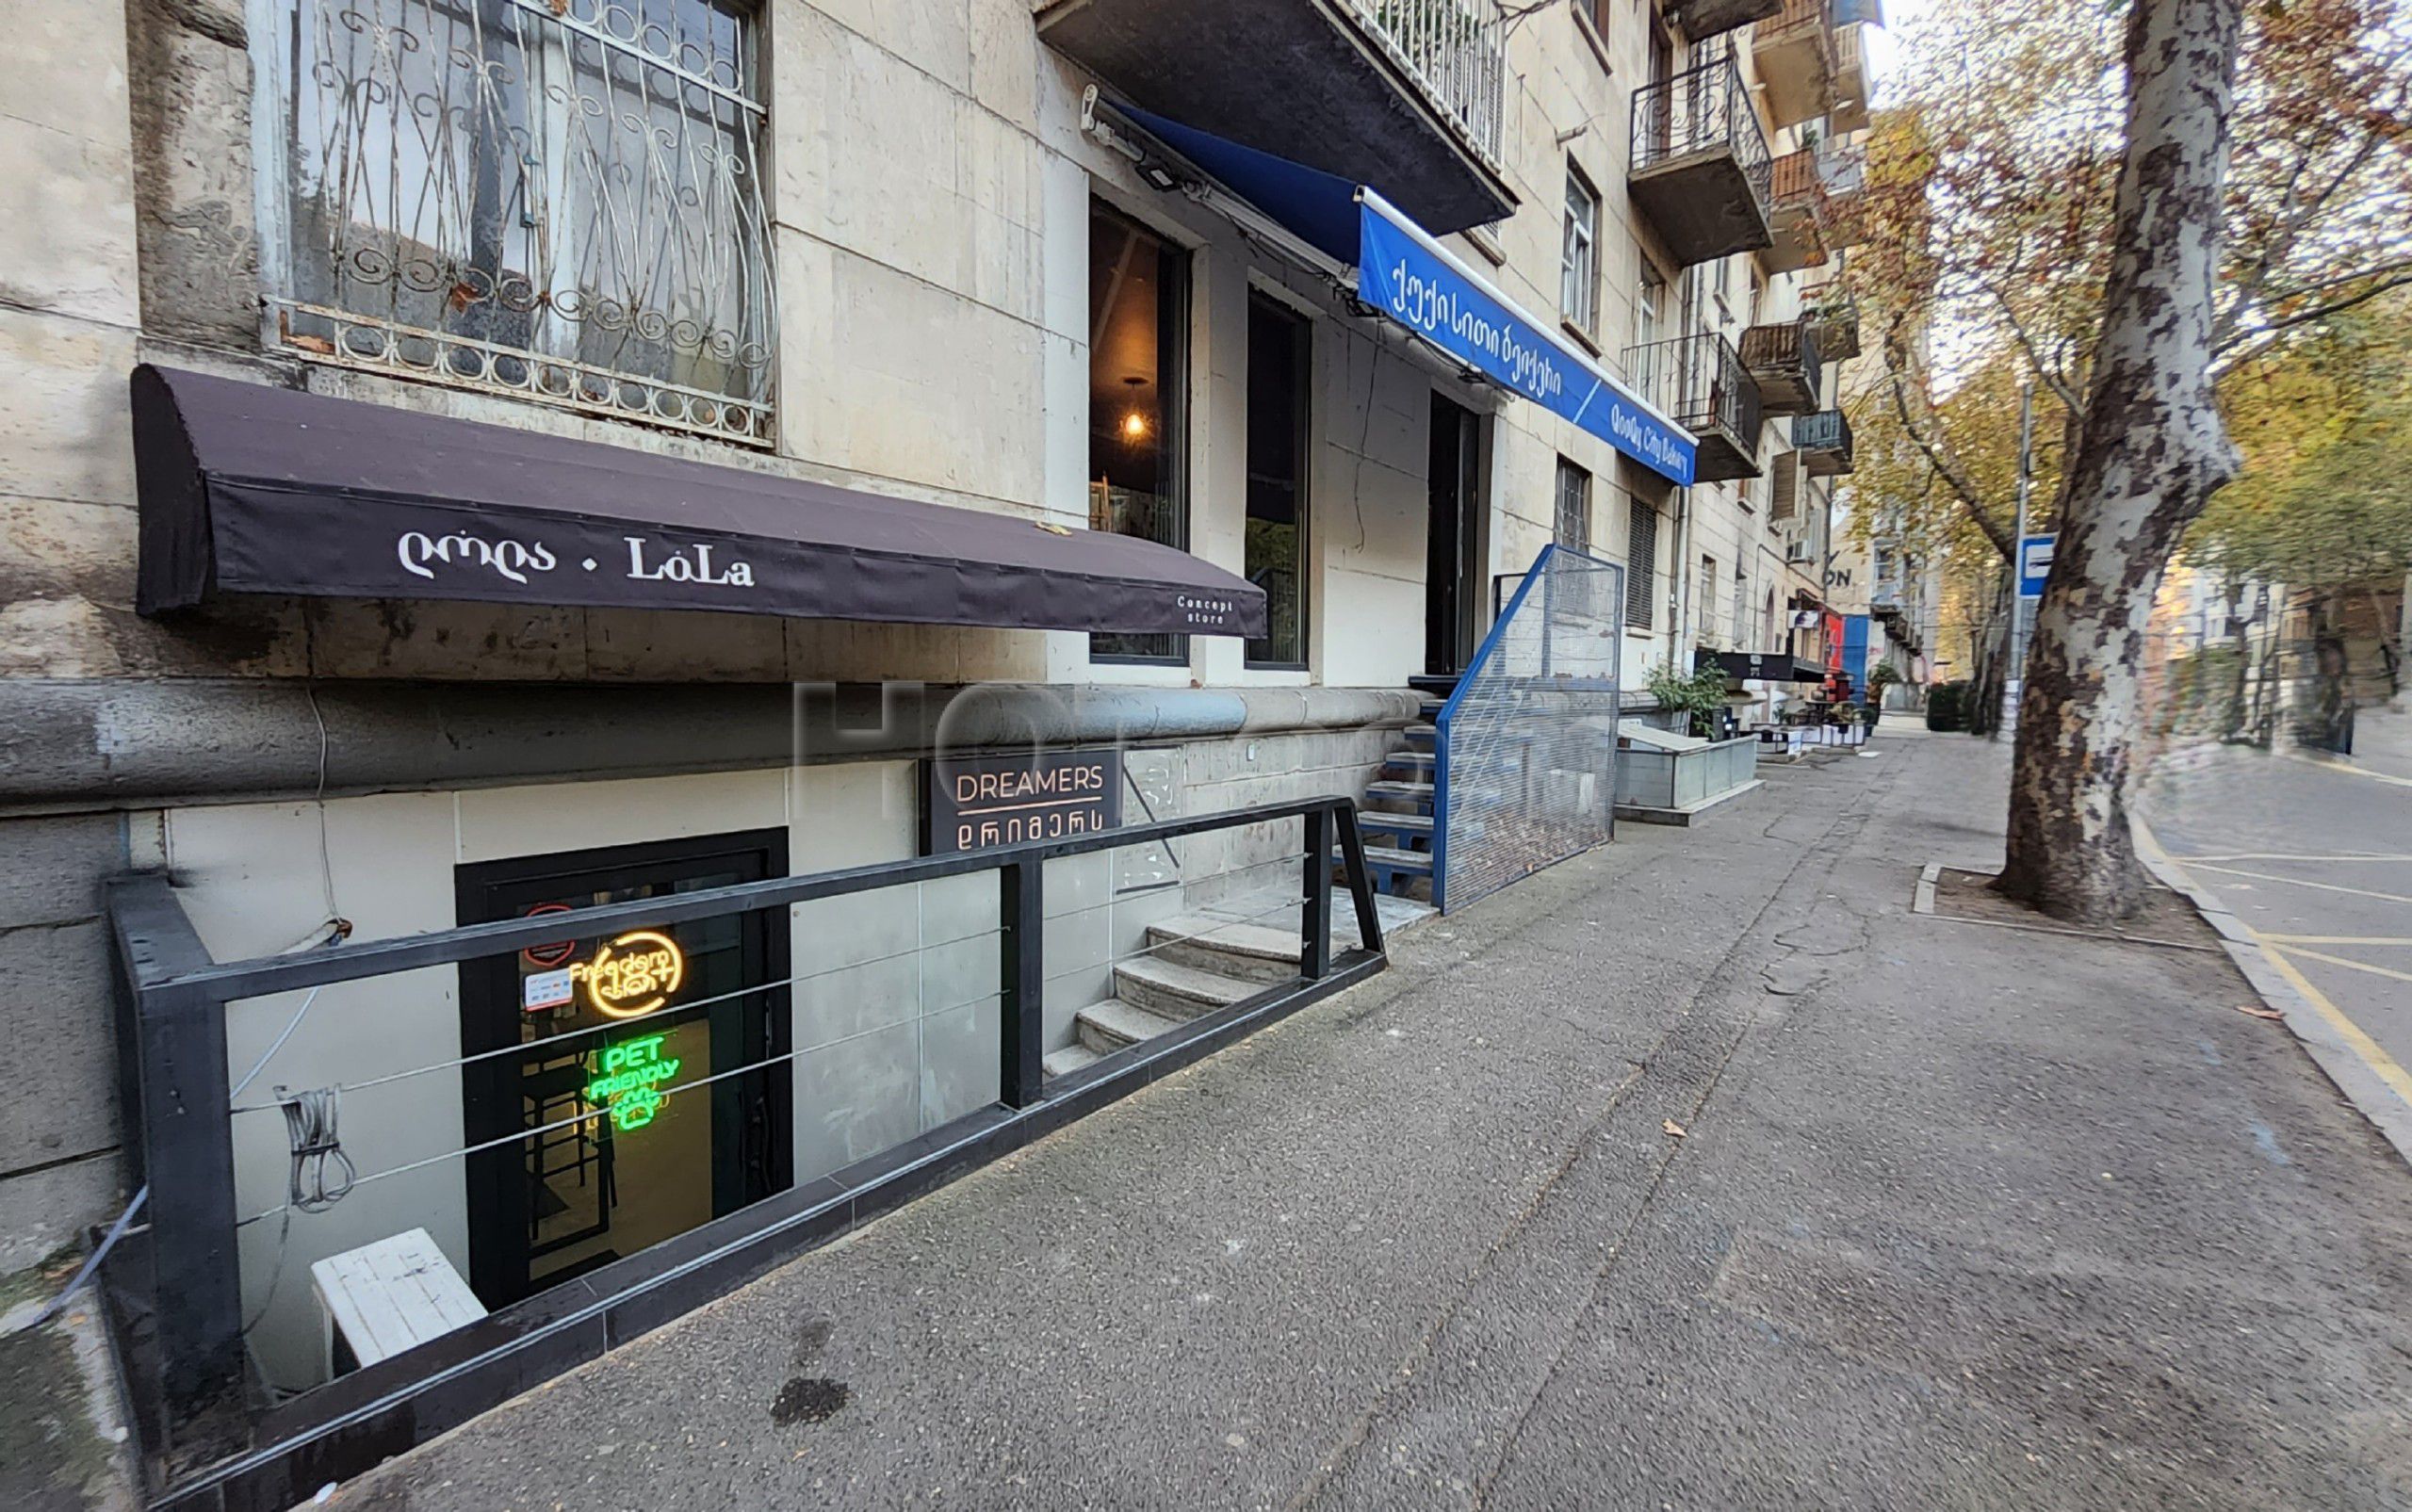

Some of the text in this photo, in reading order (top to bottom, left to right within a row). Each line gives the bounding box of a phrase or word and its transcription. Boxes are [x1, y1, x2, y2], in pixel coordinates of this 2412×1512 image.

[1177, 595, 1232, 613] Concept
[1187, 611, 1224, 625] store
[956, 765, 1103, 803] DREAMERS
[606, 1036, 664, 1072] PET
[589, 1059, 679, 1101] FRIENDLY
